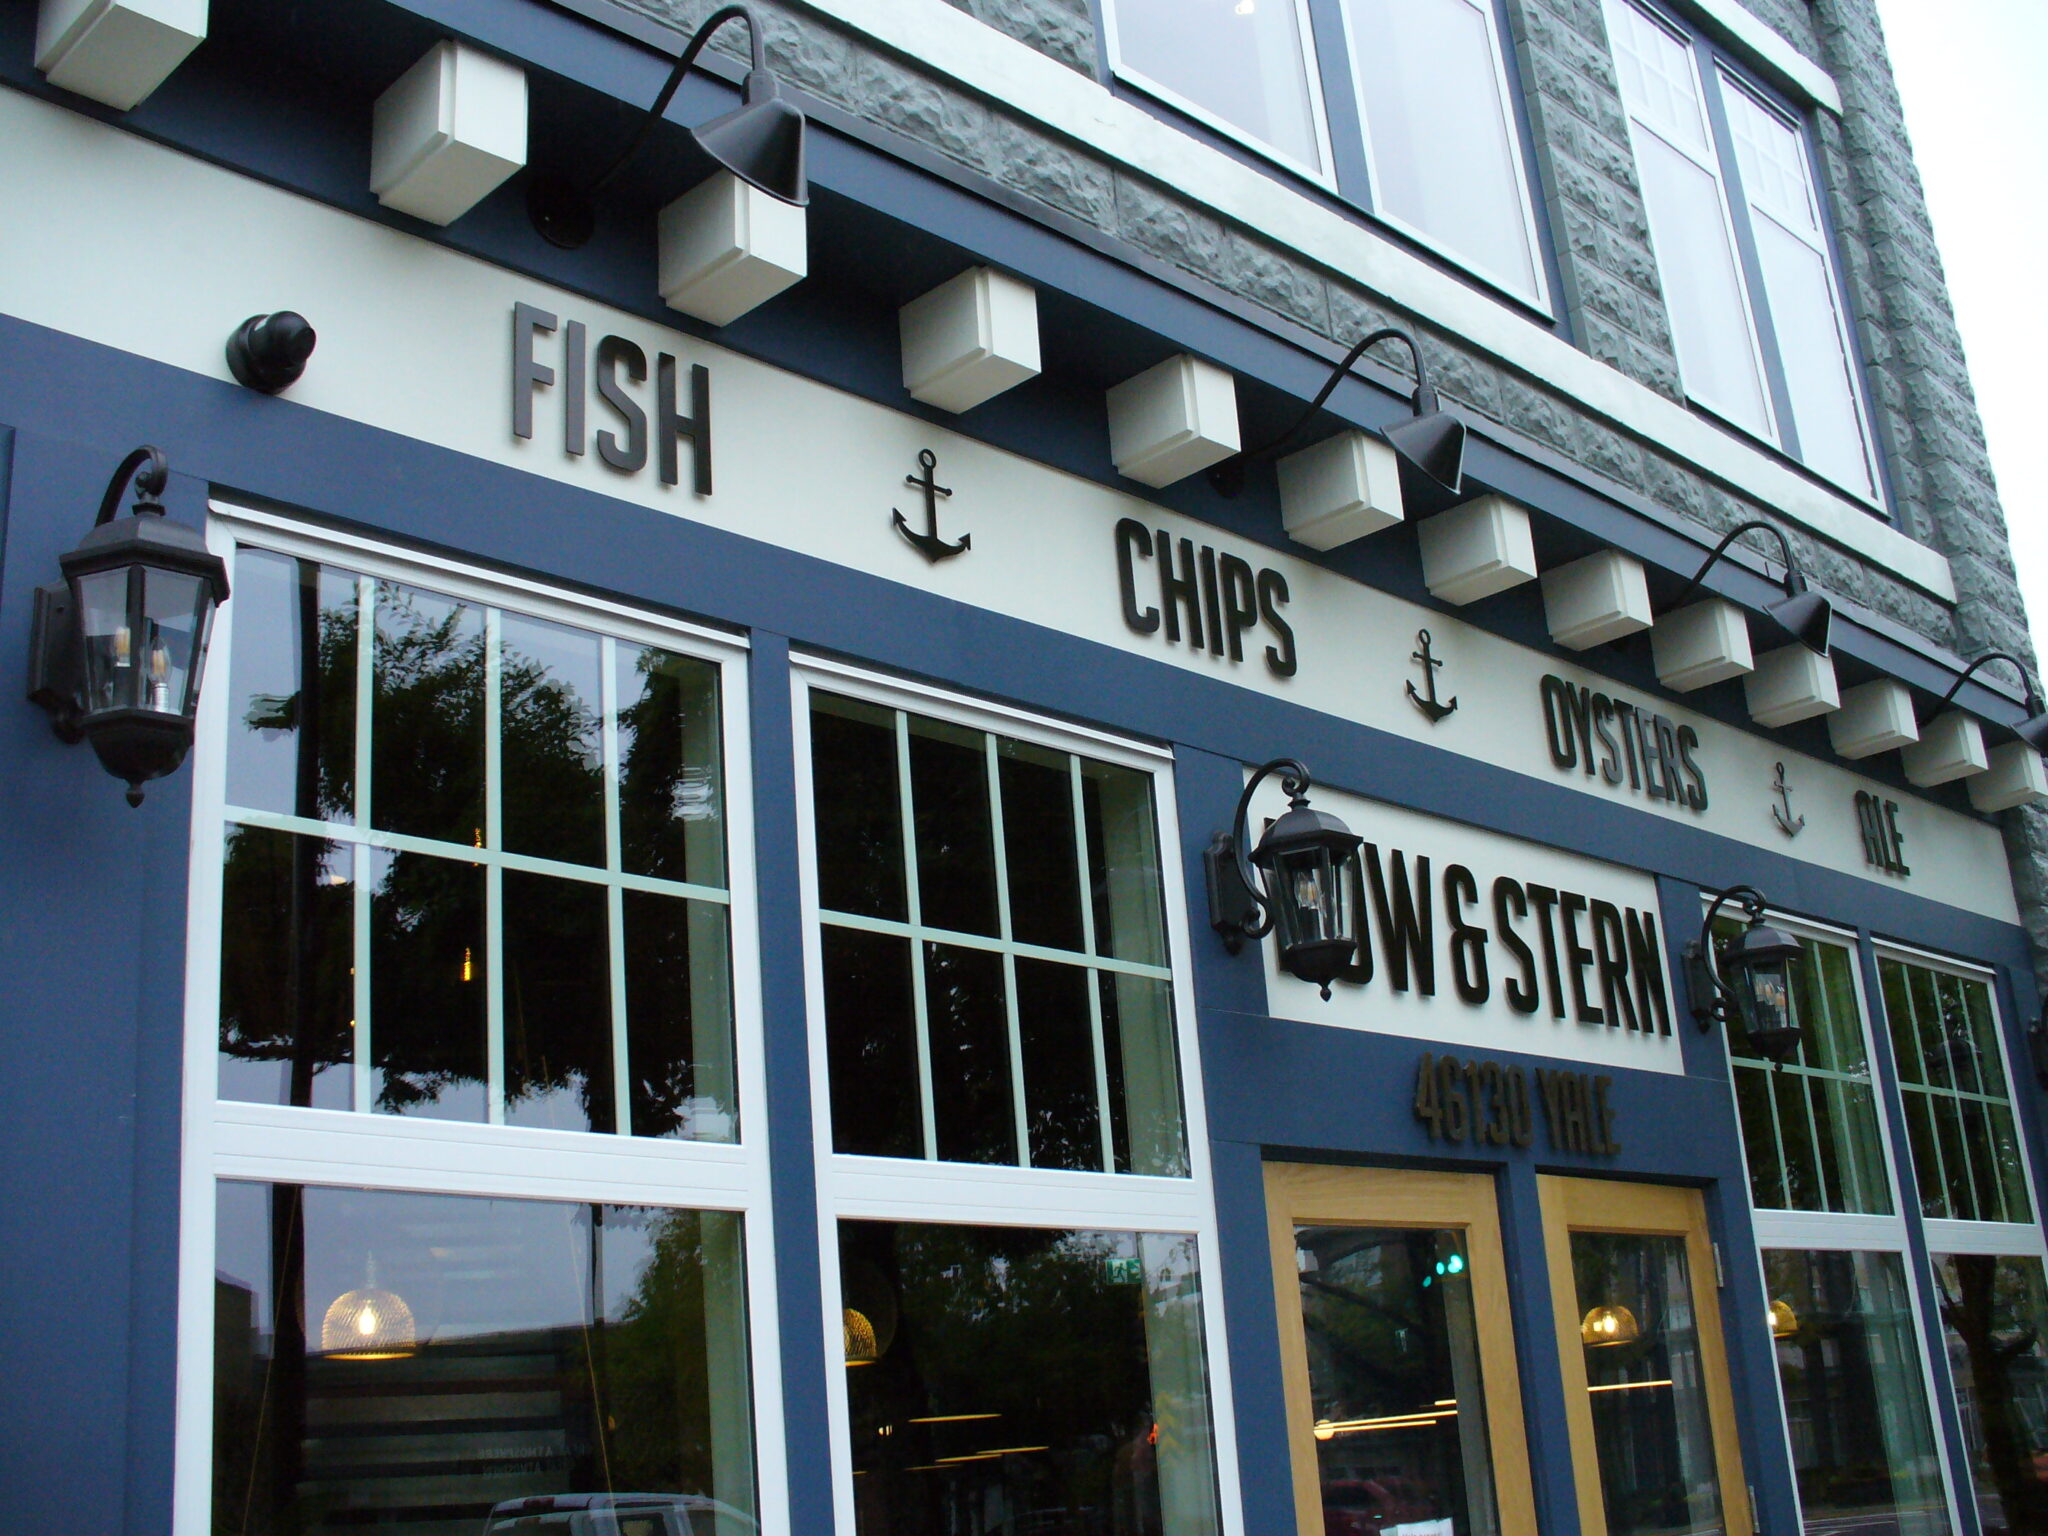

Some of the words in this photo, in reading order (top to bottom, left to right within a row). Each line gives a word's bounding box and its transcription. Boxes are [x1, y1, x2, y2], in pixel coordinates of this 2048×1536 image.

[513, 301, 713, 497] FISH
[1115, 517, 1298, 678] CHIPS
[1539, 673, 1709, 811] OYSTERS
[1853, 790, 1911, 876] ALE
[1416, 1052, 1533, 1148] 46130
[1535, 1067, 1621, 1154] YALE
